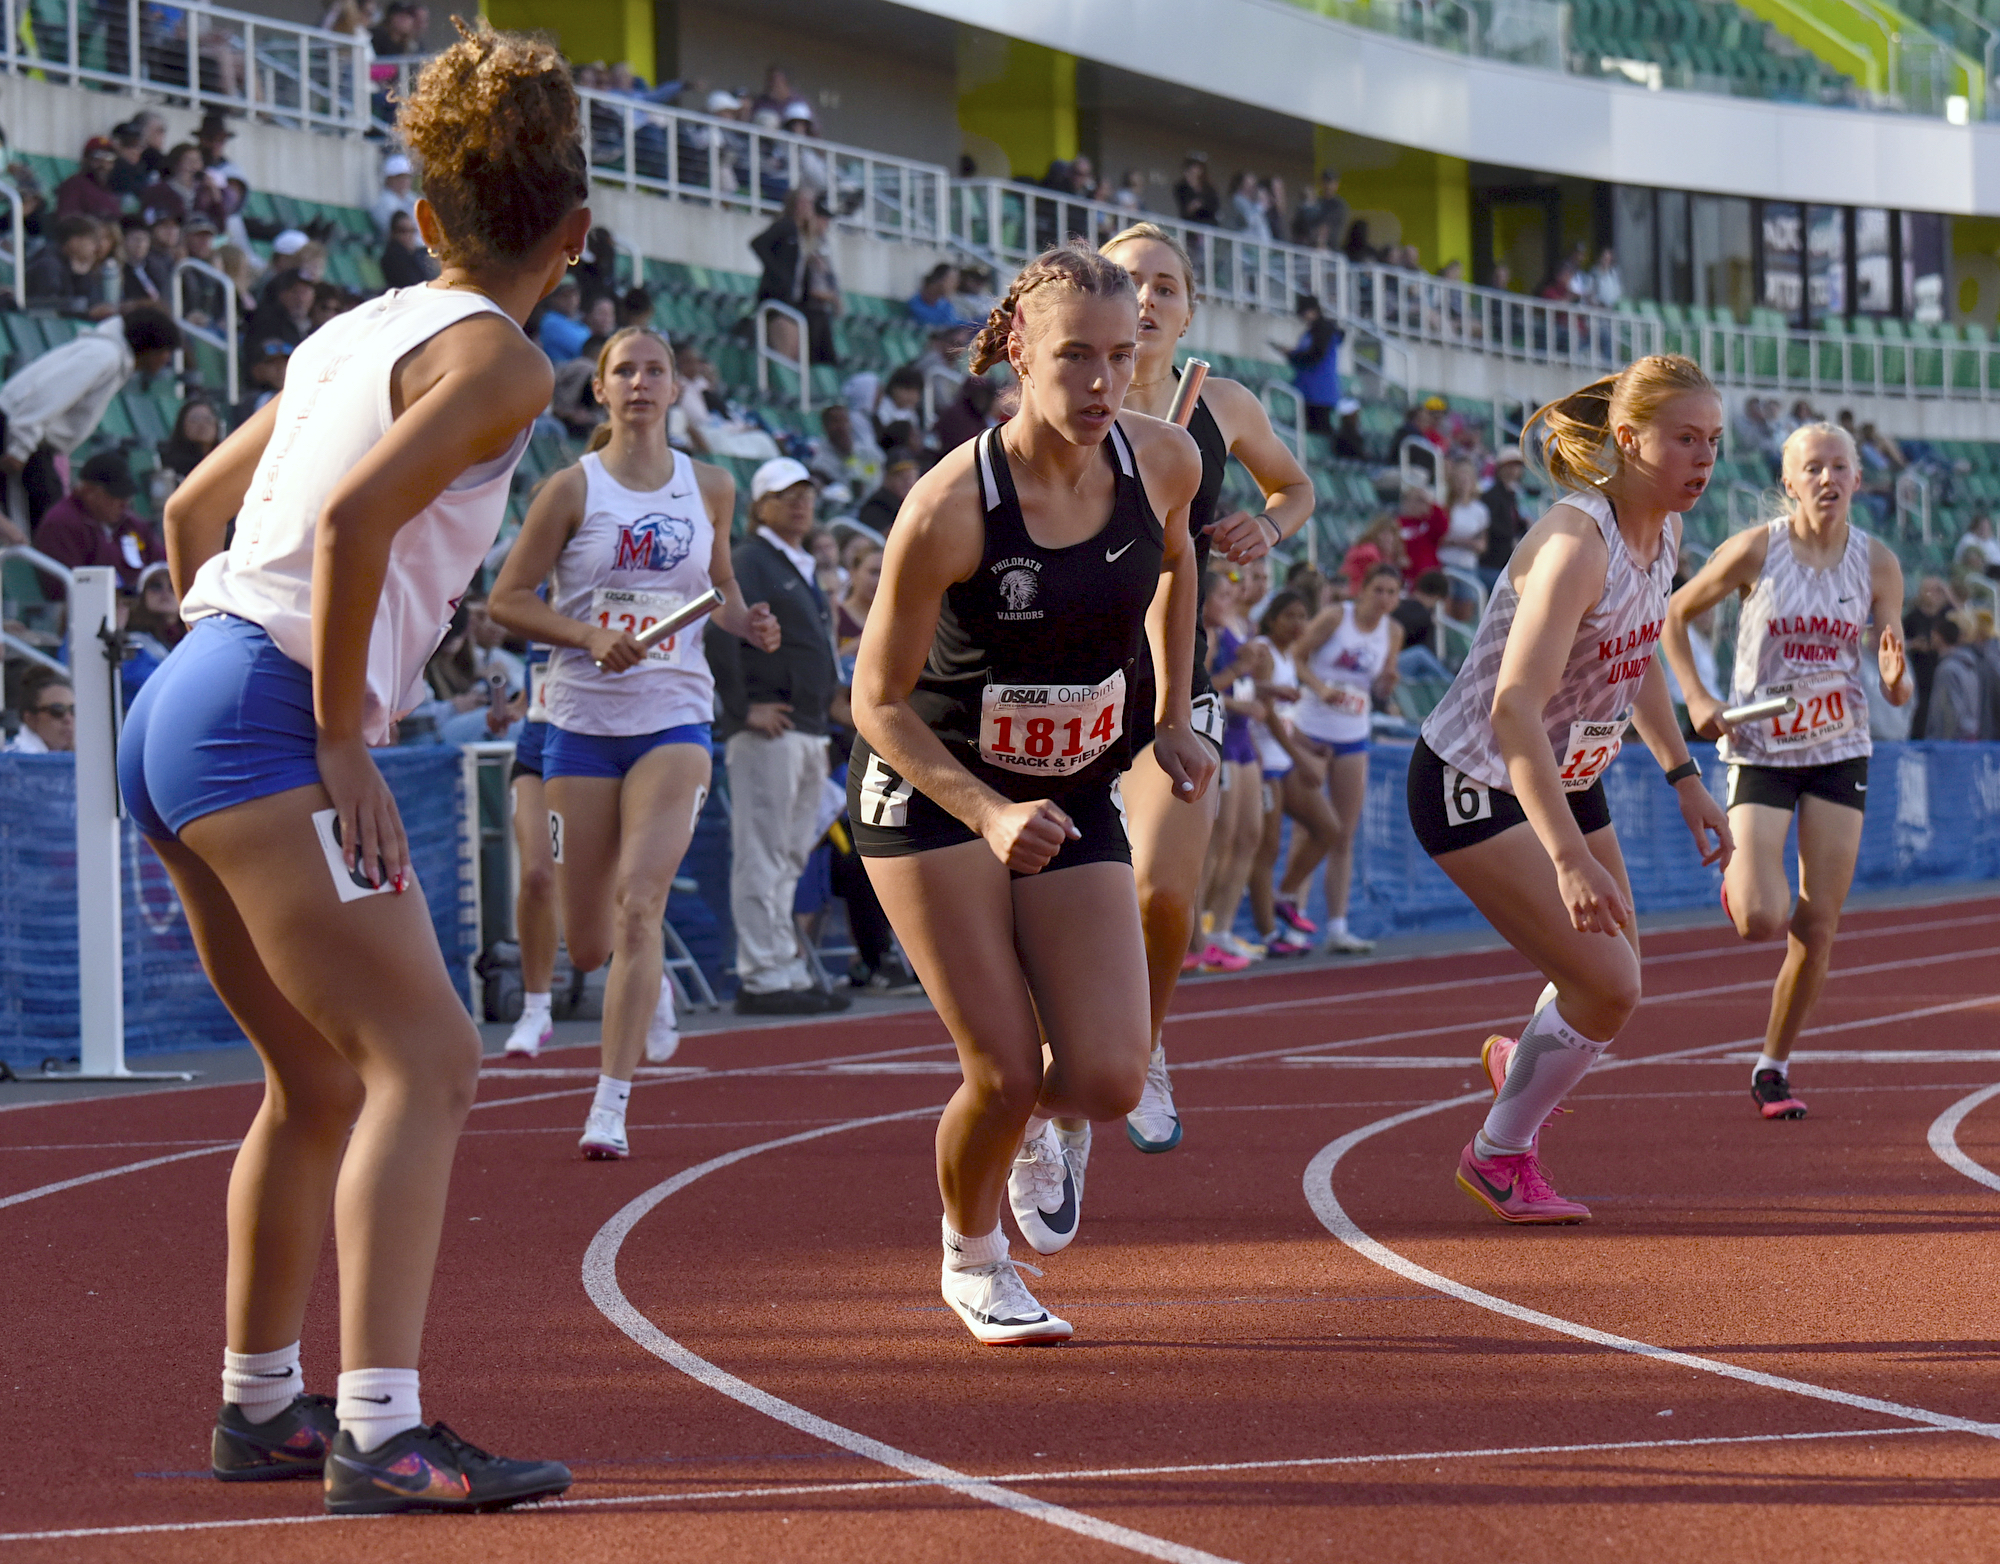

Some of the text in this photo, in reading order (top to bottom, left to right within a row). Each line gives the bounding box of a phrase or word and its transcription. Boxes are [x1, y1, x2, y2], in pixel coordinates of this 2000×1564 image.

[612, 525, 656, 571] M
[990, 557, 1043, 575] PHILOMATH
[605, 591, 635, 601] OSAA
[997, 610, 1044, 620] WARRIORS
[1598, 617, 1666, 660] KLAMA
[1767, 615, 1859, 645] KLAMATH
[1783, 642, 1839, 661] UNION
[1000, 679, 1115, 704] OSAA OnPoint
[991, 703, 1115, 758] 1814
[1584, 725, 1614, 736] OSAA
[1776, 732, 1807, 745] TRACK
[996, 744, 1107, 768] TRACK & FIELD
[872, 761, 903, 825] 7
[1453, 771, 1480, 820] 6
